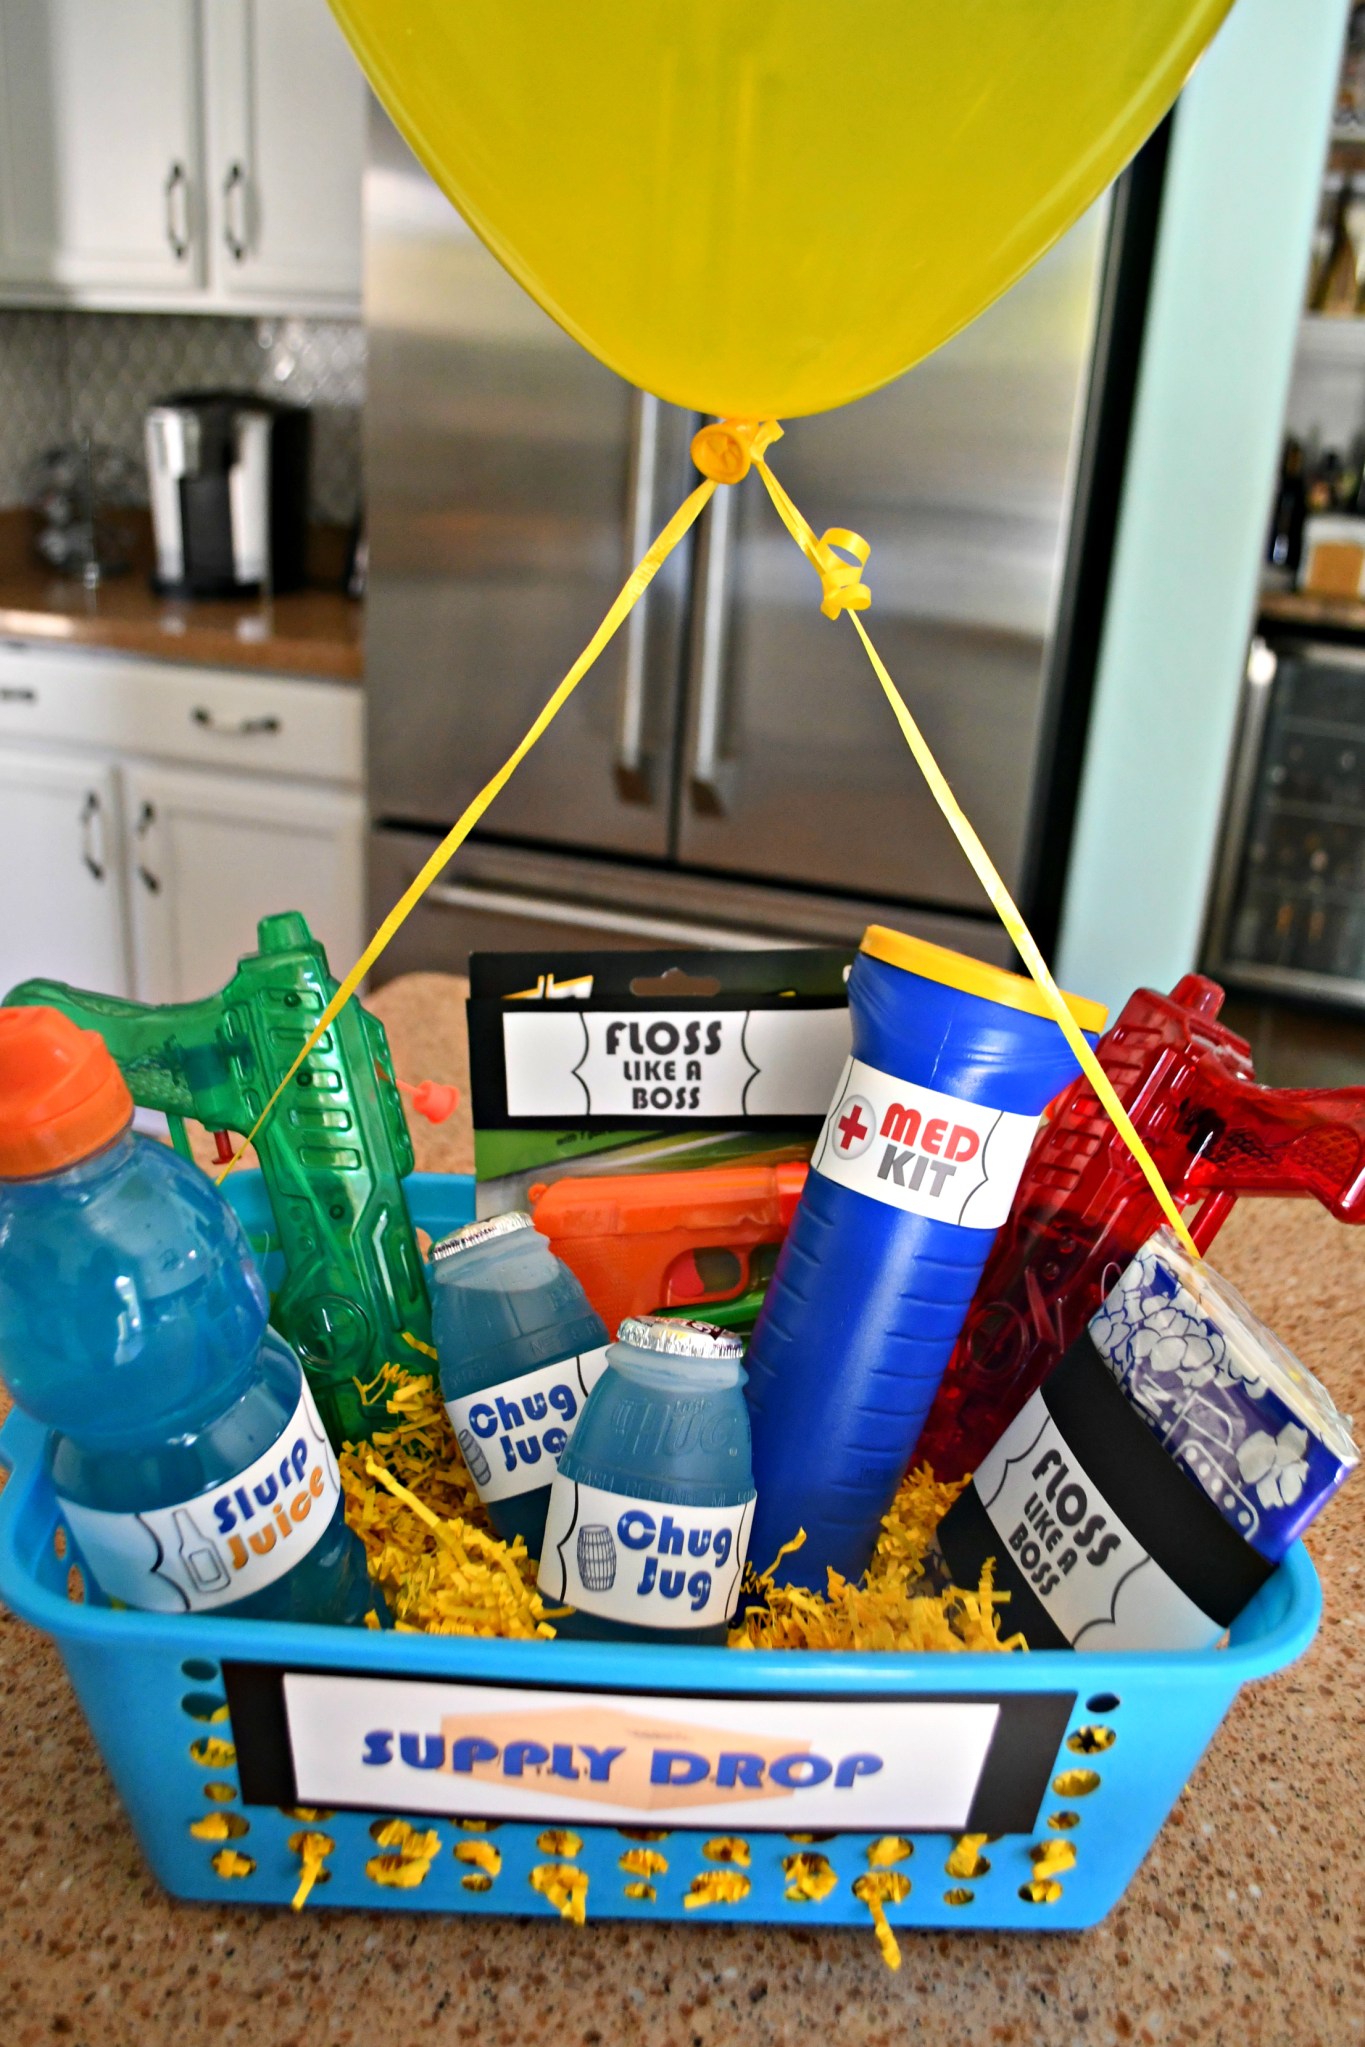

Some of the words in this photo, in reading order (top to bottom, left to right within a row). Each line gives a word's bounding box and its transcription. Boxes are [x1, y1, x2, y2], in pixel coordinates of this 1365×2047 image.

[606, 1020, 722, 1056] FLOSS
[623, 1060, 677, 1082] LIKE
[686, 1059, 702, 1082] A
[632, 1086, 700, 1110] BOSS
[879, 1102, 981, 1163] MED
[876, 1143, 958, 1198] KIT
[468, 1384, 578, 1439] Chug
[499, 1427, 569, 1473] Jug
[213, 1436, 308, 1535] Slurp
[1031, 1448, 1122, 1567] FLOSS
[226, 1465, 325, 1572] Juice
[616, 1509, 733, 1568] Chug
[1023, 1491, 1064, 1553] LIKE
[1056, 1547, 1078, 1576] A
[637, 1556, 712, 1612] Jug
[1008, 1521, 1061, 1596] BOSS
[361, 1728, 627, 1783] SUPPLY
[649, 1747, 884, 1789] DROP
